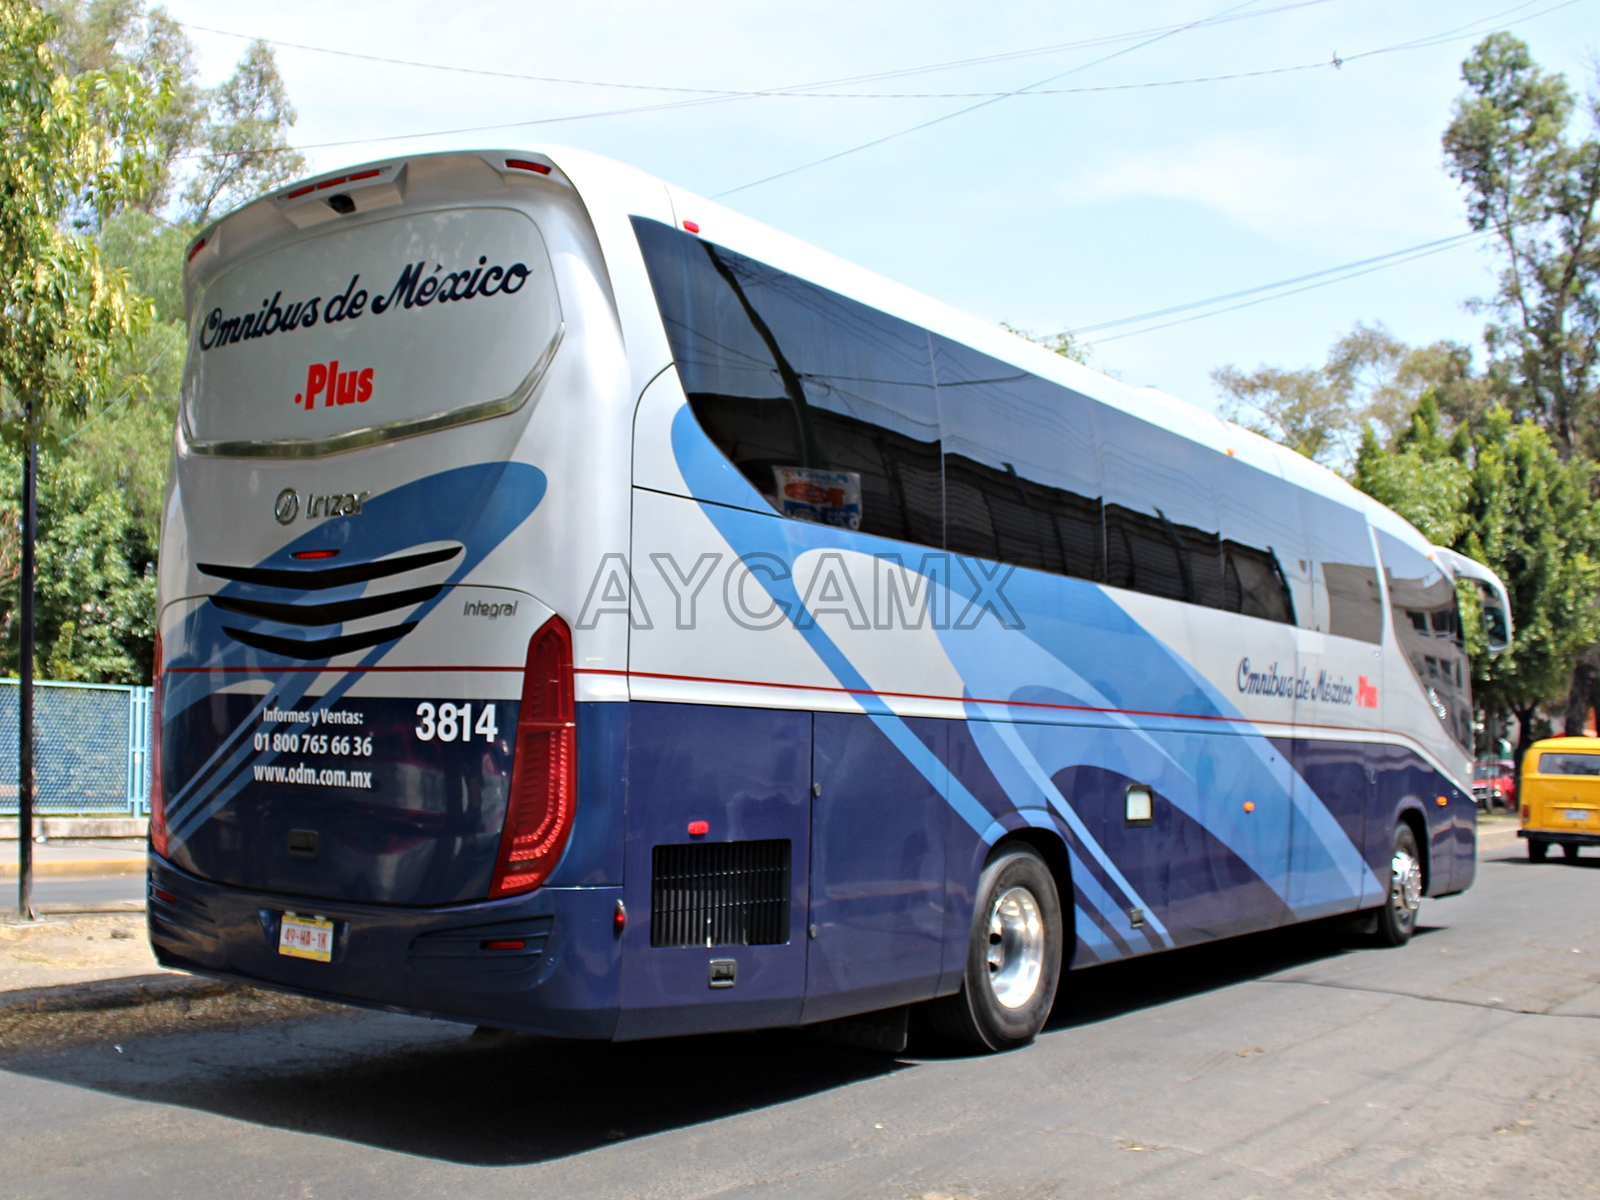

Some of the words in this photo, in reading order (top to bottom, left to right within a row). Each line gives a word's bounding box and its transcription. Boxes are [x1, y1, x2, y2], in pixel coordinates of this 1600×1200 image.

[200, 291, 322, 351] Omnibus
[323, 274, 368, 325] de
[371, 255, 533, 315] México
[306, 491, 371, 519] Irizar
[1237, 657, 1294, 699] Omnibus
[1294, 666, 1310, 701] de
[263, 706, 310, 723] Informes
[311, 711, 319, 727] y
[320, 708, 364, 725] Ventas:
[415, 702, 499, 743] 3814
[254, 732, 270, 752] 01
[272, 732, 299, 753] 800
[301, 734, 328, 755] 765
[330, 735, 351, 756] 66
[352, 736, 373, 757] 36
[253, 762, 372, 789] www.odm.com.mx
